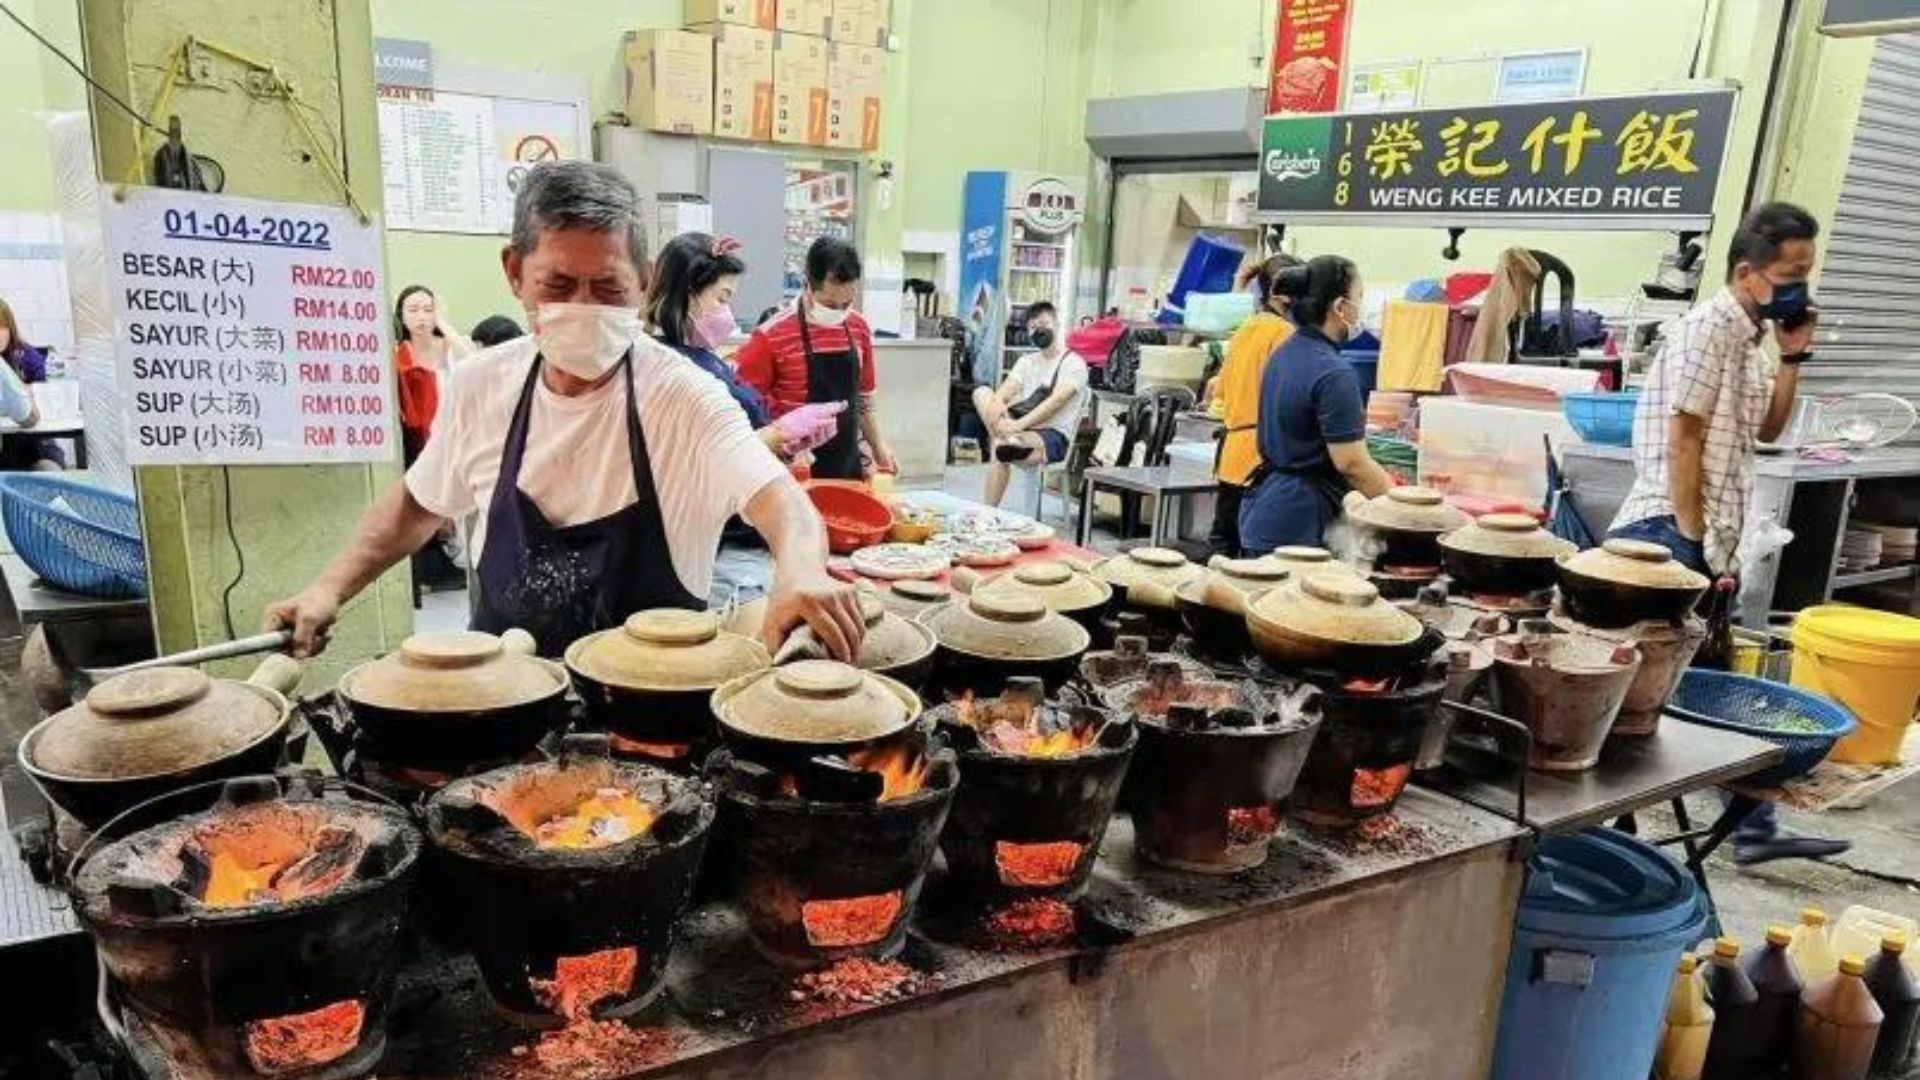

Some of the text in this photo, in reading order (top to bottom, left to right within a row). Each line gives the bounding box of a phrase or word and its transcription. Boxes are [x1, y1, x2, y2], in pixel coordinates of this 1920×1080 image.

[1364, 108, 1699, 180] 榮記什飯
[1266, 148, 1320, 180] Carlsberg
[1370, 186, 1683, 208] WENG KEE MIXED RICE
[164, 209, 331, 247] 01-04-2022
[123, 252, 206, 280] BESAR
[291, 265, 374, 289] RM22.00
[126, 289, 198, 313] KECIL
[294, 297, 377, 322] RM14.00
[130, 323, 209, 347] SAYUR
[296, 330, 379, 353] RM10.00
[133, 357, 212, 380] SAYUR
[299, 364, 331, 383] RM
[342, 365, 380, 384] 8.00
[137, 392, 184, 414] SUP
[302, 395, 382, 415] RM10.00
[140, 426, 186, 447] SUP
[304, 426, 334, 445] RM
[346, 426, 384, 445] 8.00
